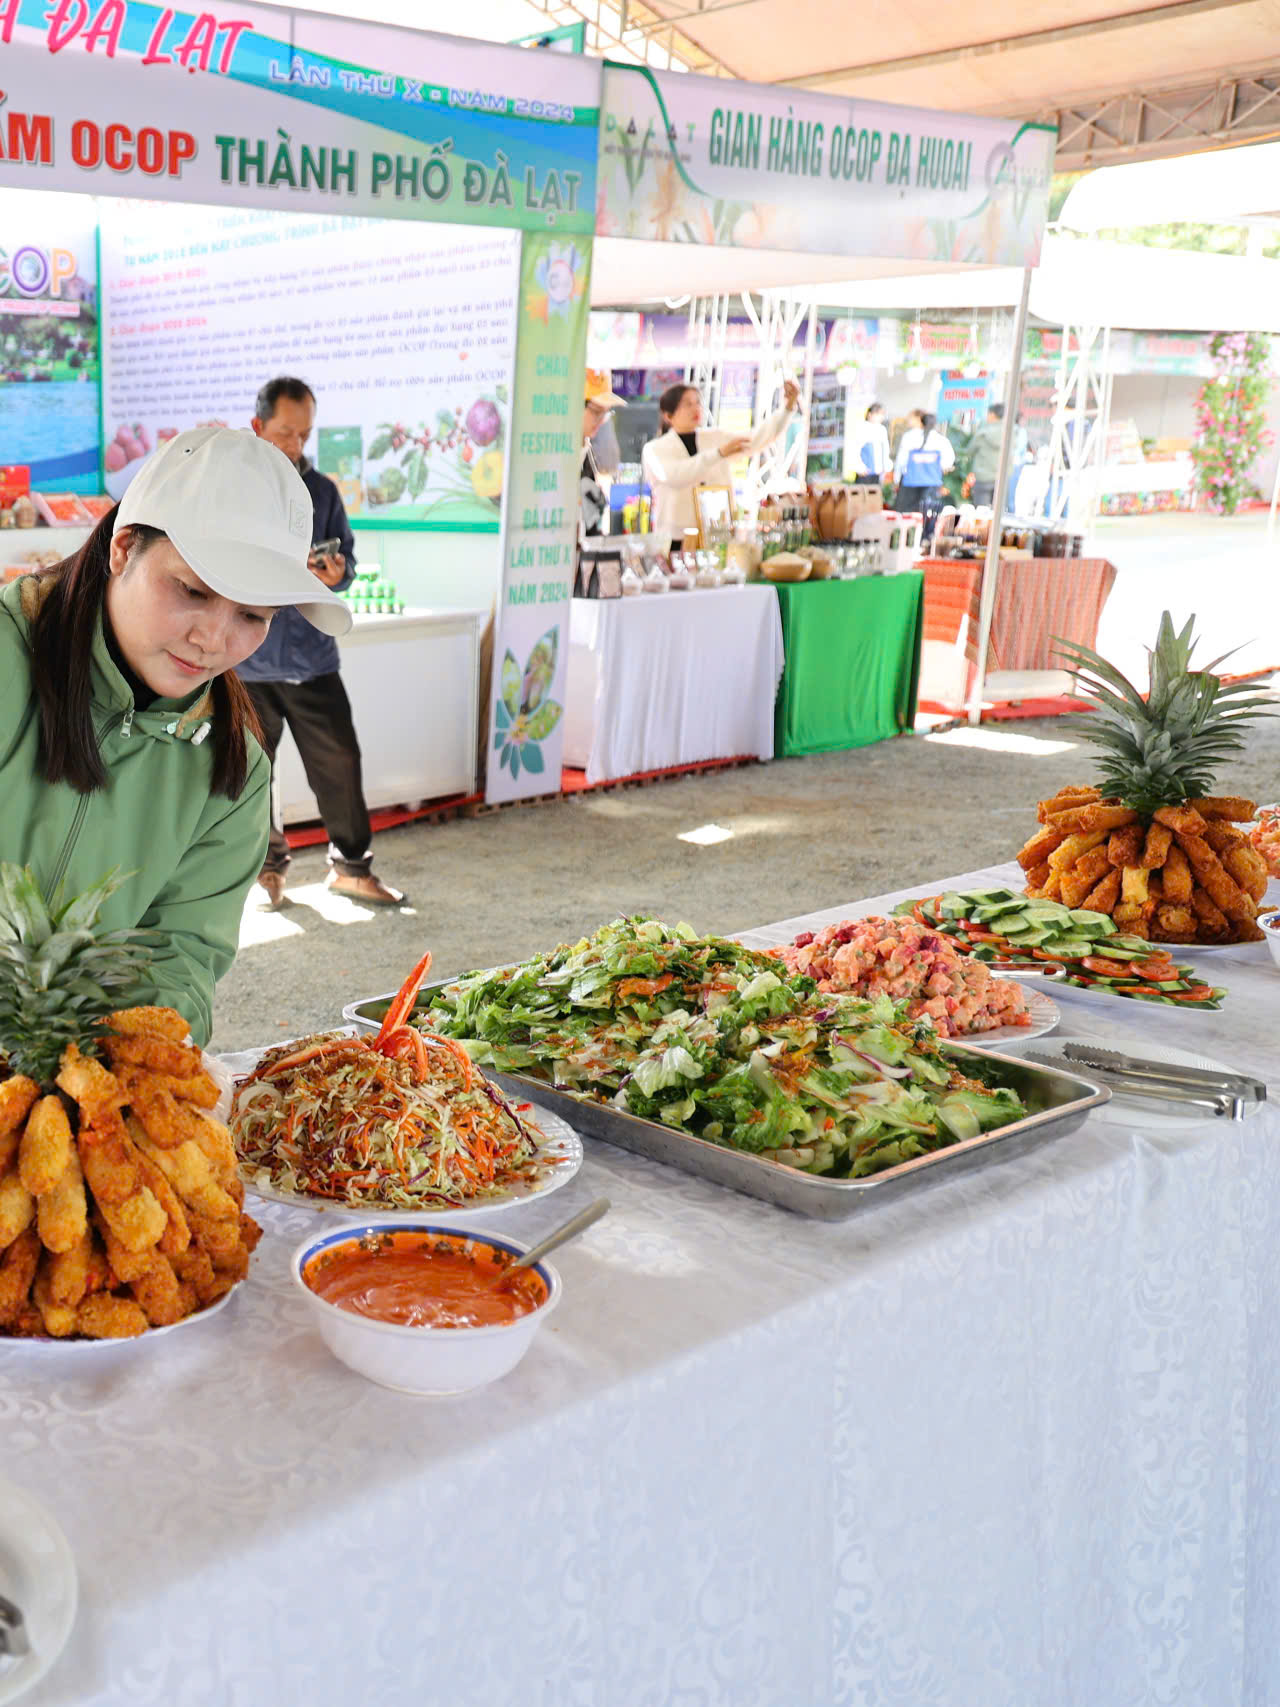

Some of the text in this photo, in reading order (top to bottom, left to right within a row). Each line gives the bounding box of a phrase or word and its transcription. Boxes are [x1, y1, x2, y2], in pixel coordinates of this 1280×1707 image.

[141, 8, 254, 73] LẠT
[270, 55, 331, 88] LẦN
[340, 69, 396, 97] THỨ
[403, 80, 425, 103] X
[449, 87, 508, 113] NĂM
[514, 99, 576, 122] 2024
[70, 118, 198, 178] OCOP
[215, 127, 359, 196] THÀNH
[370, 137, 455, 201] PHỐ
[463, 150, 516, 207] ĐÀ
[525, 166, 583, 226] LẠT
[709, 107, 762, 169] GIAN
[767, 104, 825, 177] HÀNG
[829, 124, 882, 183] OCOP
[886, 131, 911, 199] ĐẠ
[520, 431, 575, 455] FESTIVAL
[533, 470, 558, 492] HOA
[563, 544, 573, 565] X
